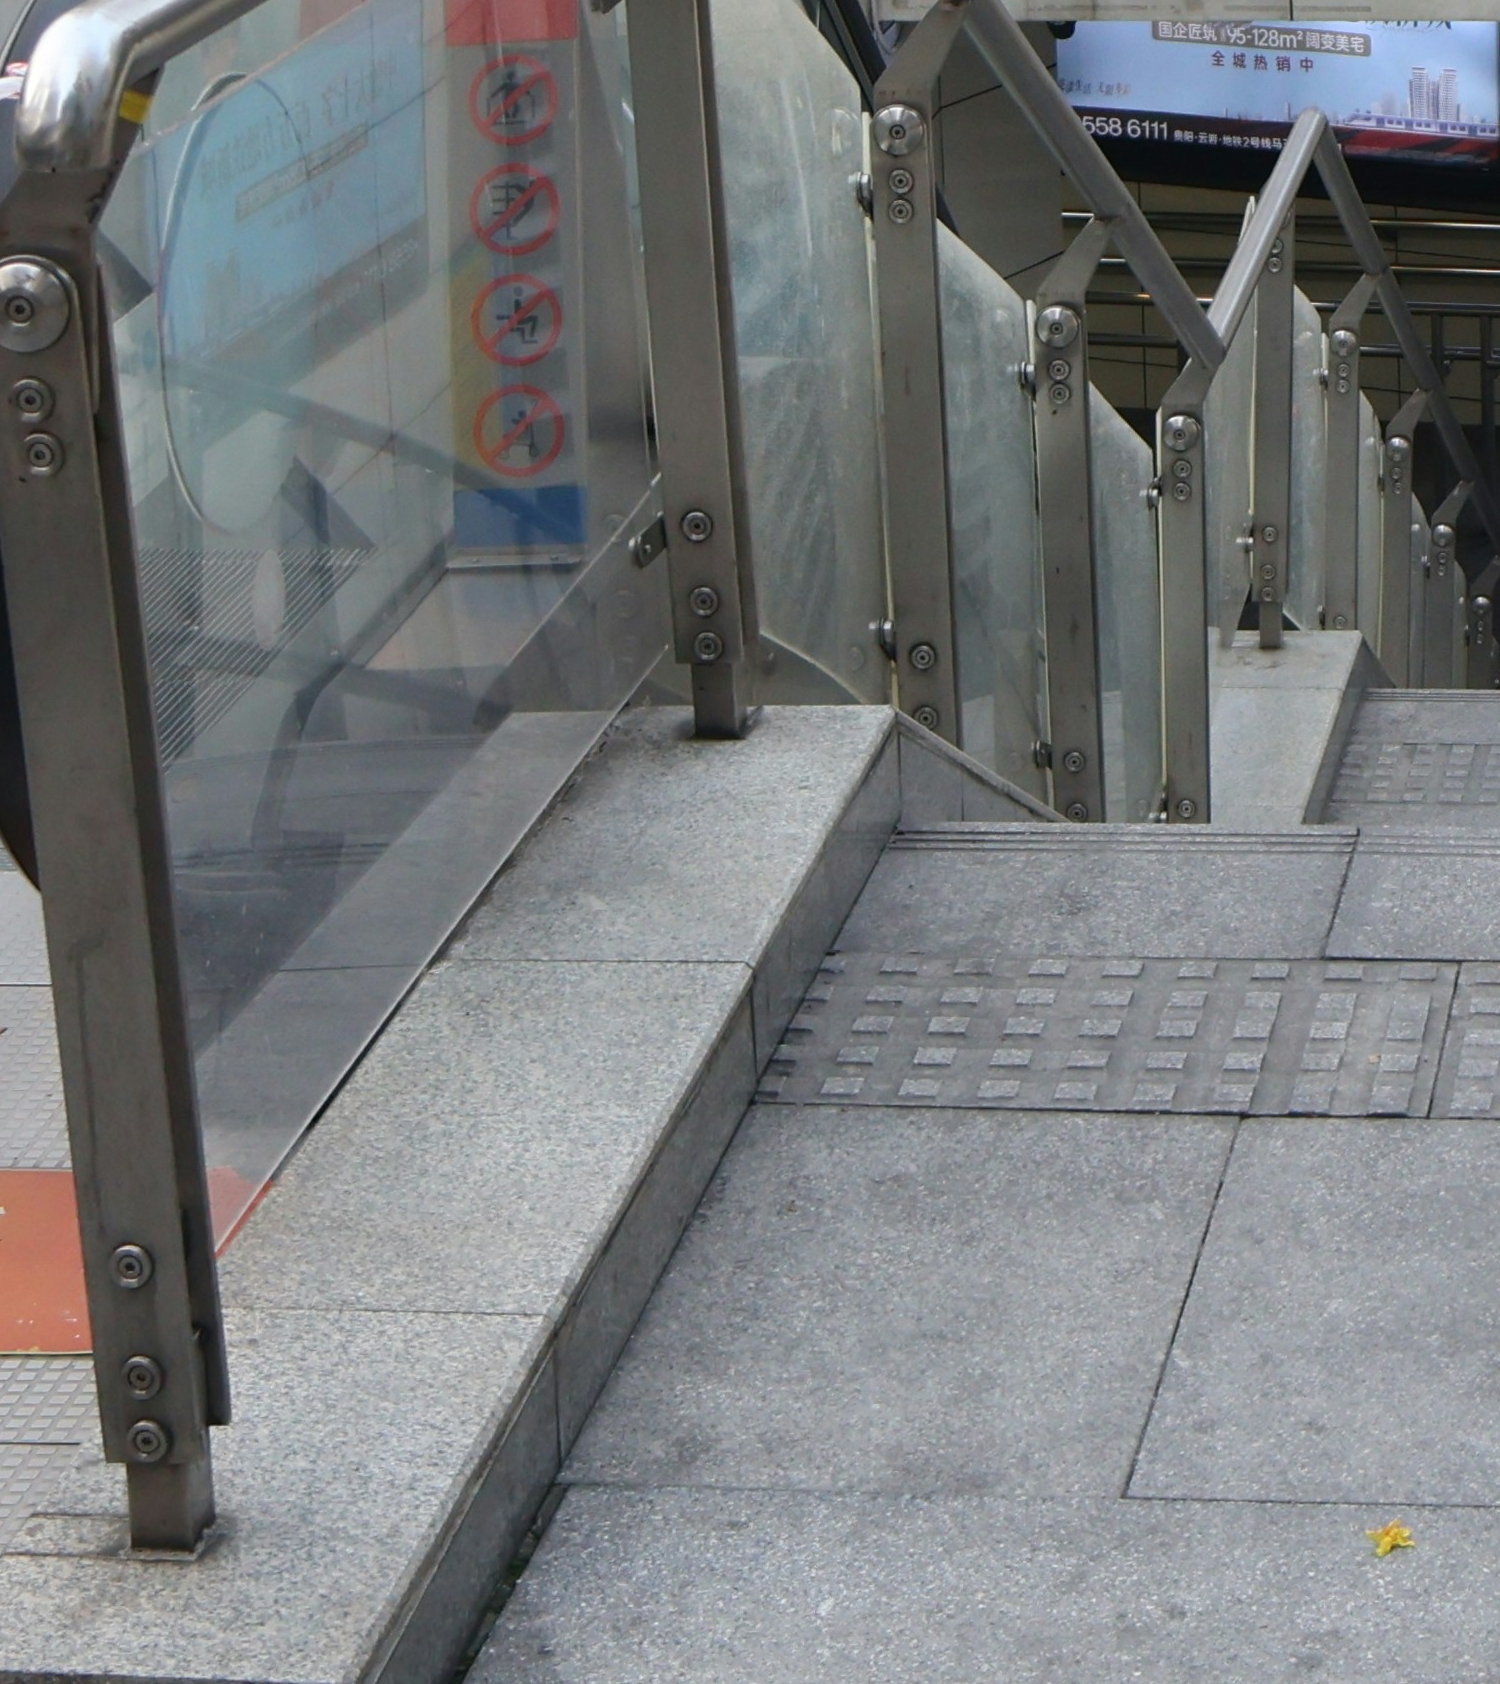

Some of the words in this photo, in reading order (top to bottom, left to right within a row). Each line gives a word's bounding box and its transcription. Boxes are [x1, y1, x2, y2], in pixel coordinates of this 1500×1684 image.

[1305, 31, 1365, 53] 阔变美宅
[1211, 50, 1315, 73] 全城热销中
[1127, 120, 1168, 140] 6111
